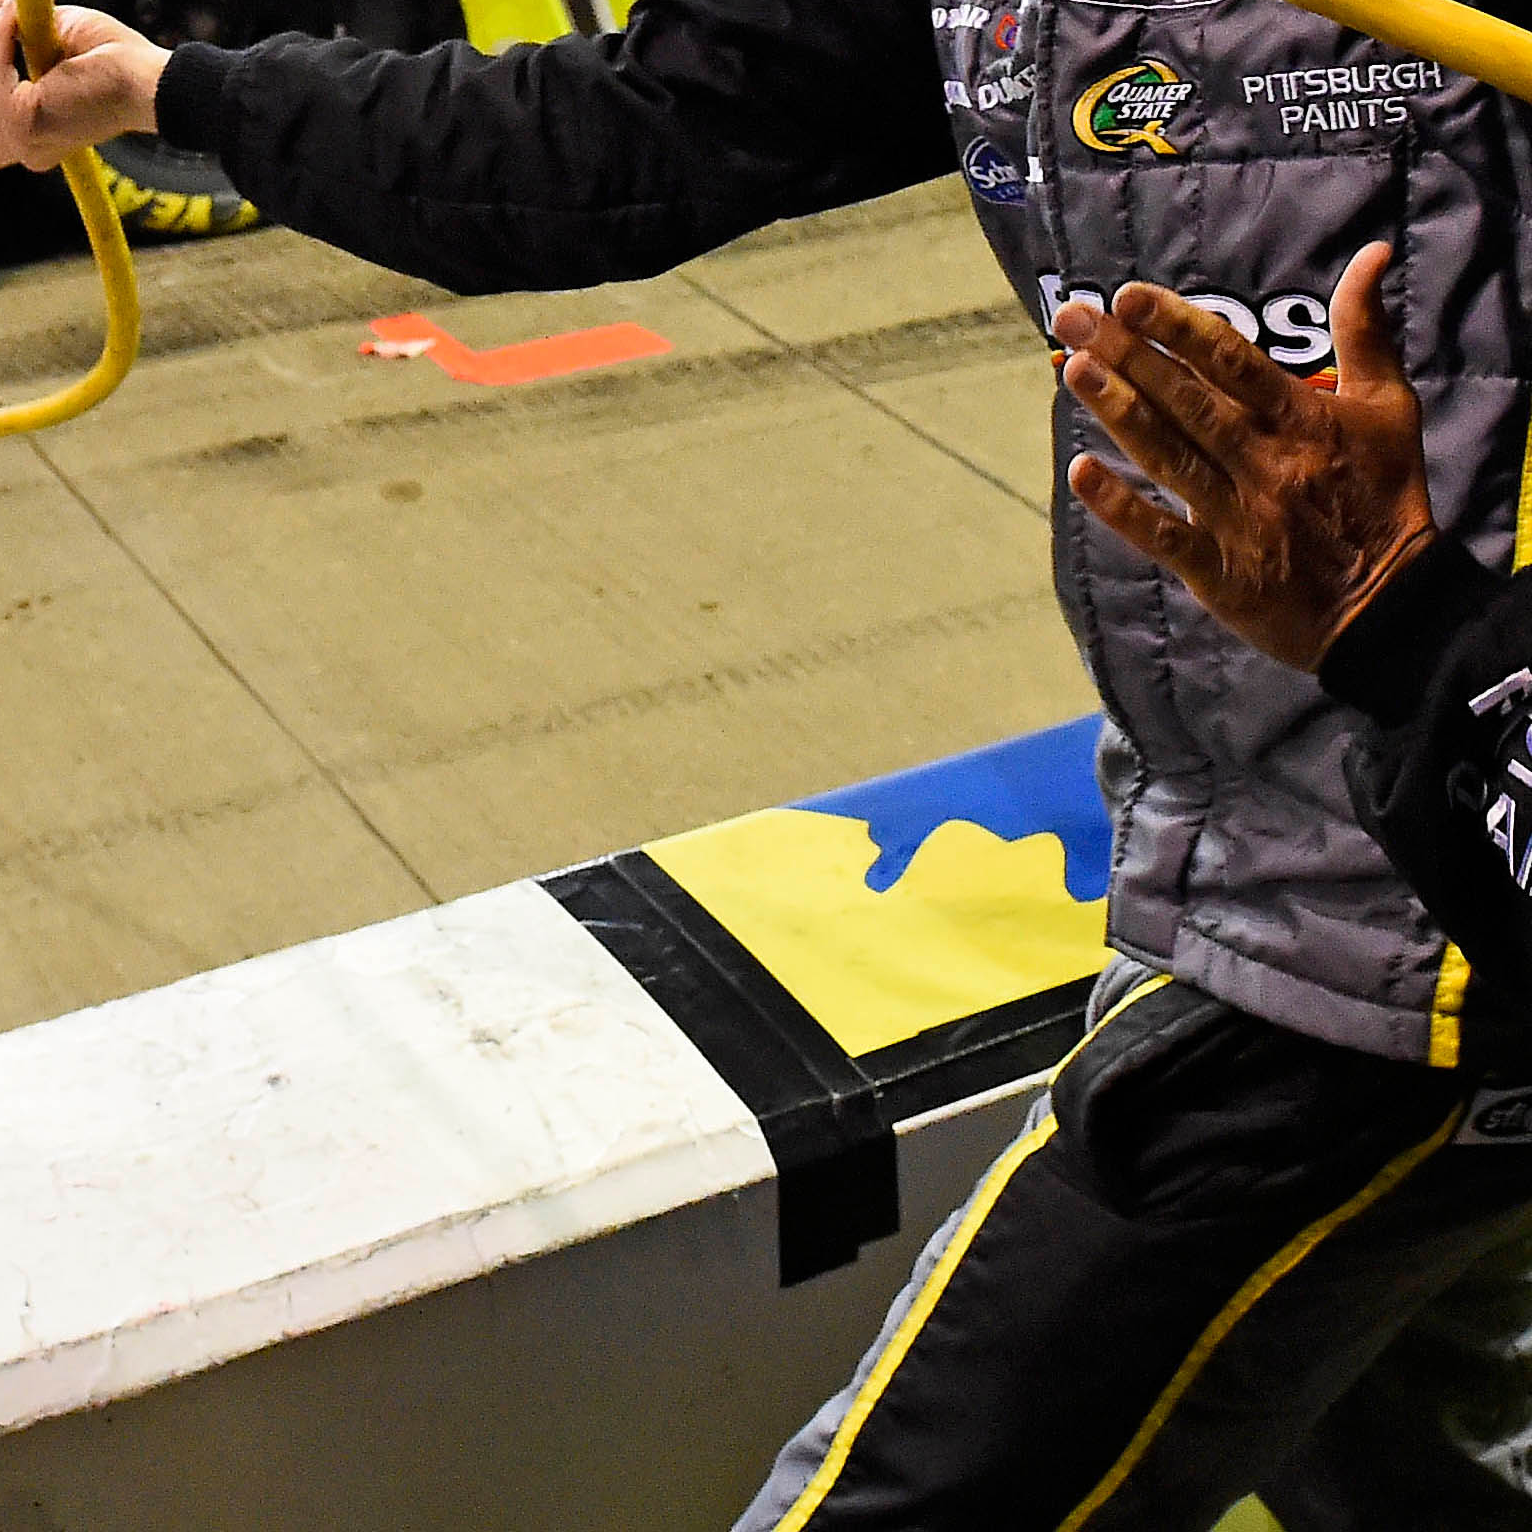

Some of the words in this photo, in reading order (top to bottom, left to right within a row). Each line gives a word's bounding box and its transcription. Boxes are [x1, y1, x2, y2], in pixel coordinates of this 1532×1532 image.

[1107, 82, 1193, 104] QUAKER
[1242, 62, 1444, 104] PITTSBURGH
[1117, 102, 1174, 120] STATE
[1279, 97, 1408, 135] PAINTS
